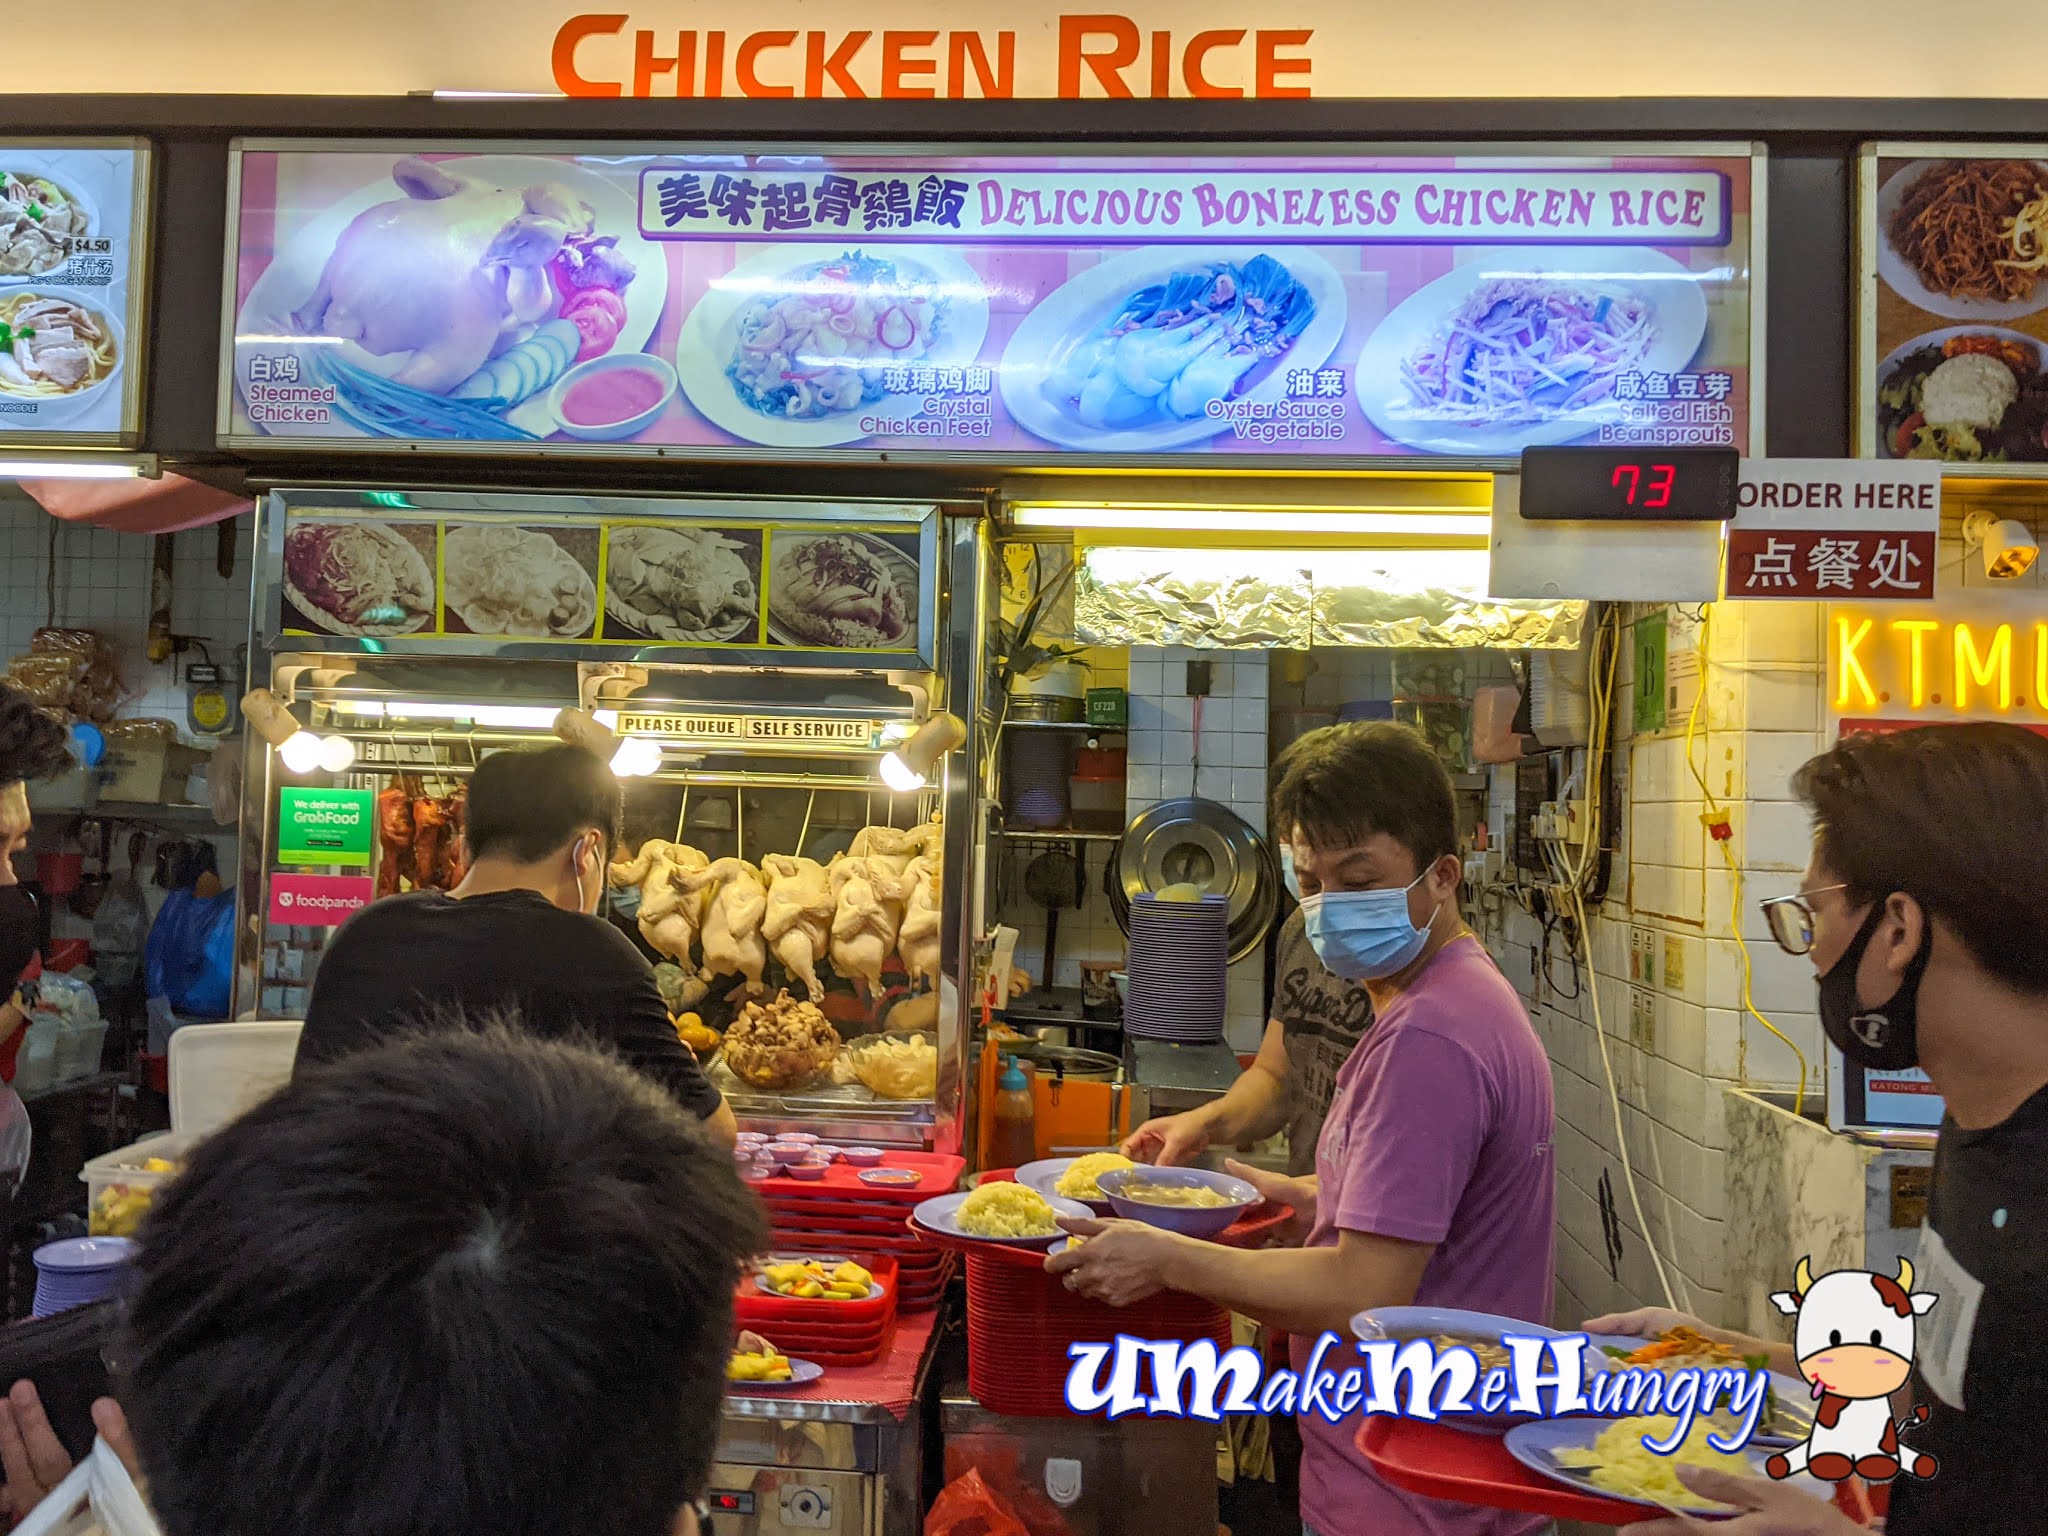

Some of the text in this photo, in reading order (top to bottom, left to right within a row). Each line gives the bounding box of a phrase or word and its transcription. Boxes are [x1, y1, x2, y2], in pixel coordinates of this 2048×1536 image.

[551, 14, 1315, 98] CHICKEN RICE
[977, 179, 1706, 227] DELICIOUS BONELESS CHICKEN RICE
[75, 240, 109, 253] $4.50
[68, 259, 113, 275] 猪什汤
[53, 276, 87, 285] ORGAN
[87, 277, 111, 286] SOUP
[250, 355, 299, 382] 白鸡
[883, 367, 991, 394] 玻璃鸡脚
[1287, 369, 1345, 397] 油菜
[1614, 371, 1732, 400] 咸鱼豆芽
[250, 384, 335, 401] Steamed
[249, 404, 329, 421] Chicken
[923, 397, 991, 416] Crystal
[1206, 399, 1344, 420] Oyster Sauce
[1620, 403, 1732, 421] Salted Fish
[859, 416, 991, 435] Chicken Feet
[1233, 420, 1344, 441] Vegetable
[1601, 424, 1733, 444] Beansprouts
[1611, 464, 1677, 508] 73
[1736, 482, 1935, 510] ORDER HERE
[1744, 537, 1922, 591] 点餐处
[624, 717, 736, 735] PLEASE QUEUE
[752, 721, 864, 738] SELF SERVICE
[293, 800, 360, 811] We deliver with
[293, 811, 360, 826] GrabFood
[296, 893, 365, 911] foodpanda
